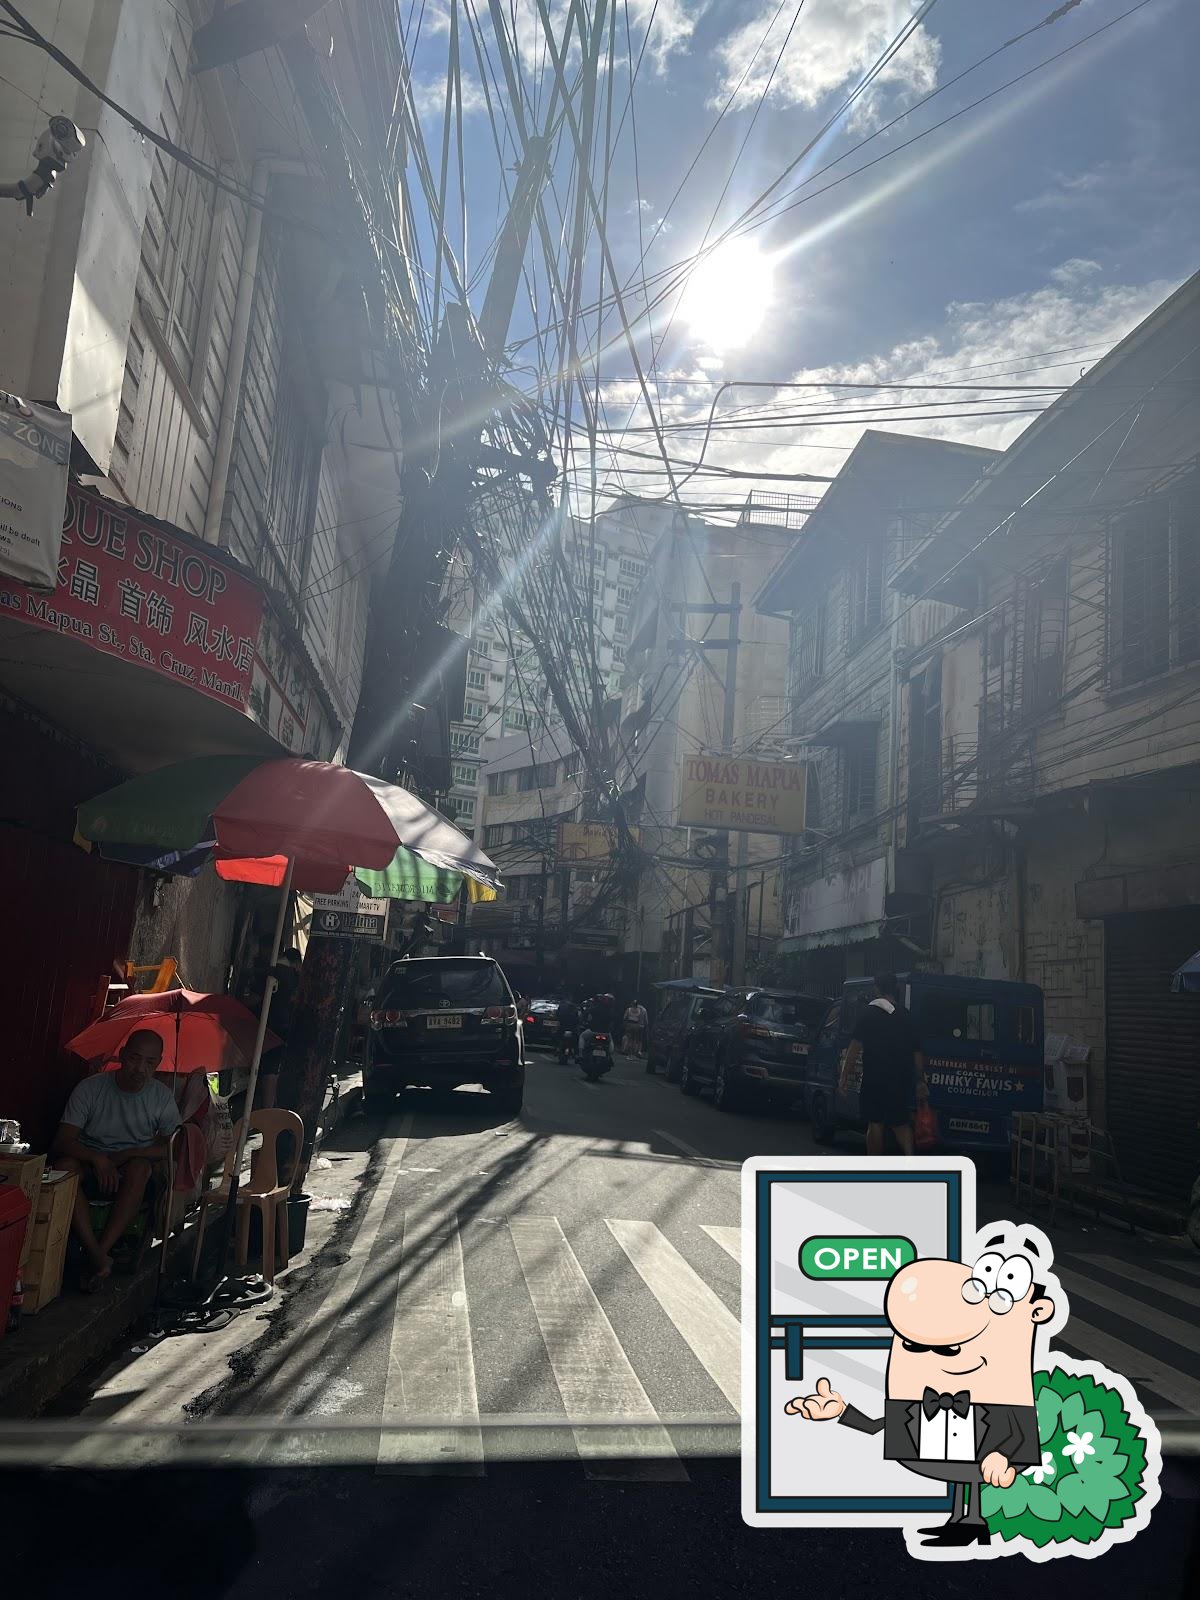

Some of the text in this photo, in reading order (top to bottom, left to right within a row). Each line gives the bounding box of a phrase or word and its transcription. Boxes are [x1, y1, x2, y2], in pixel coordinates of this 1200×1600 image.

[13, 421, 66, 462] ZONE
[0, 495, 23, 512] IONS
[134, 529, 227, 605] SHOP
[118, 578, 174, 635] 首饰
[184, 611, 254, 675] 风水店
[26, 594, 93, 638] Mapua
[129, 636, 156, 665] Sta.
[160, 651, 198, 686] Cruz,
[687, 759, 801, 791] TOMAS MAPUA
[705, 788, 780, 810] BAKERY
[704, 808, 777, 826] HOT PANDESAL
[931, 1073, 1014, 1092] BINKY FAVIS
[957, 1070, 986, 1079] COACH
[947, 1086, 999, 1097] COUNCILOR
